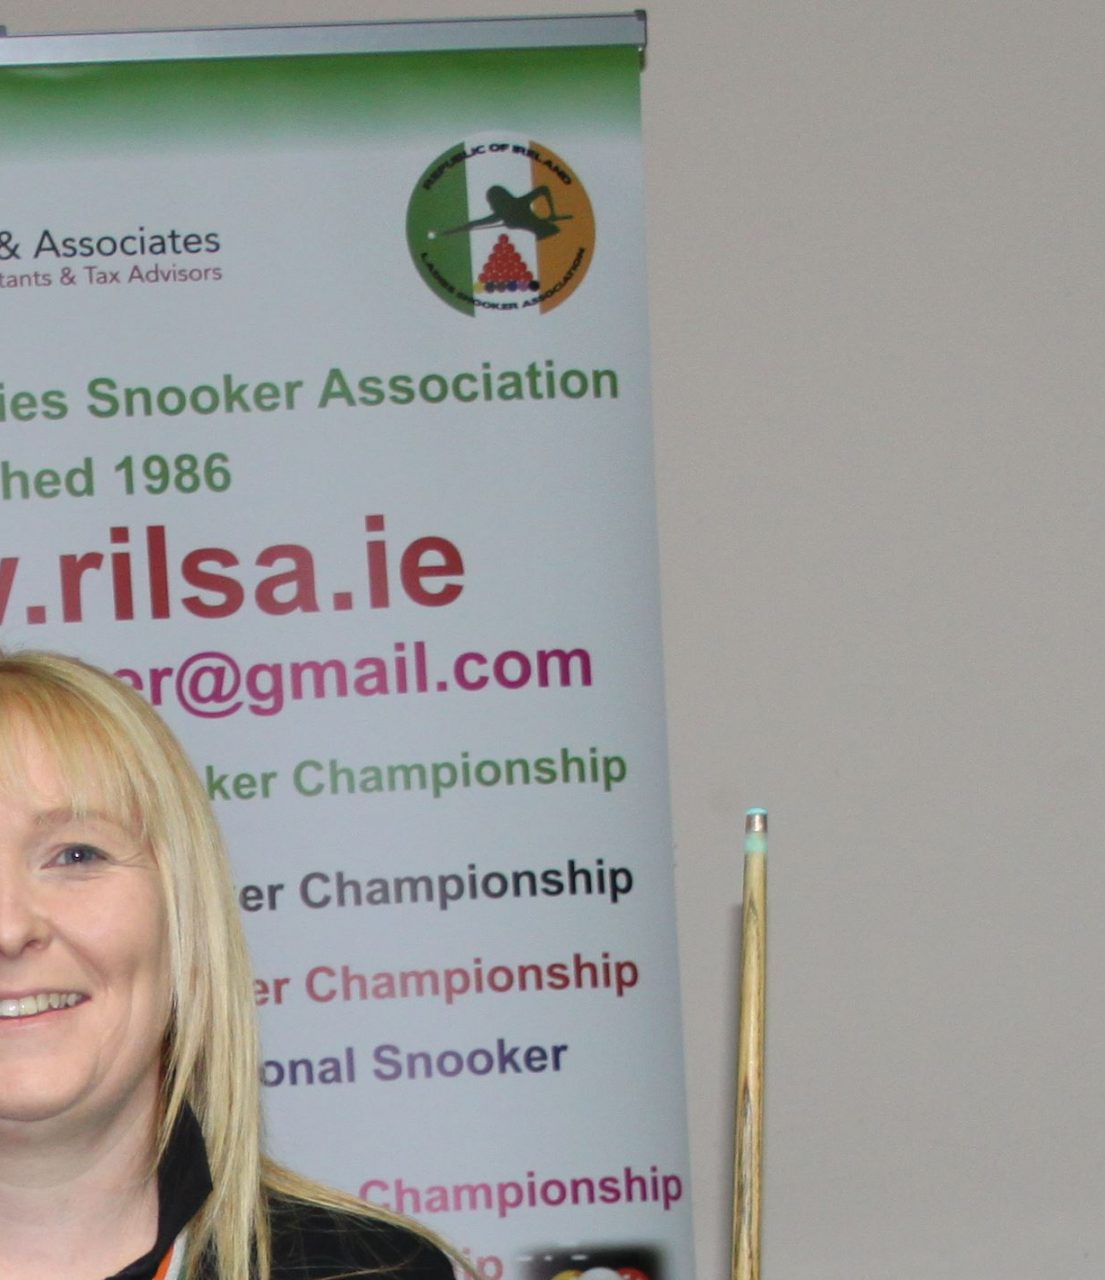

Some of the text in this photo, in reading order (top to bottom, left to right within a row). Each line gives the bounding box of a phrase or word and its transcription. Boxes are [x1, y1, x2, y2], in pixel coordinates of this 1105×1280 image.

[422, 143, 572, 190] REPUBLIC OF IRELAND
[33, 226, 221, 259] Associates
[60, 267, 77, 286] &
[84, 265, 121, 285] Tax
[127, 263, 223, 284] Advisors
[522, 247, 586, 309] ASSOCIATION
[86, 372, 304, 420] Snooker
[318, 360, 619, 410] Association
[114, 451, 232, 496] 1986
[293, 747, 627, 799] Championship
[298, 859, 634, 911] Championship
[304, 952, 639, 1003] Championship
[373, 1038, 568, 1082] Snooker
[359, 1166, 683, 1218] Championship
